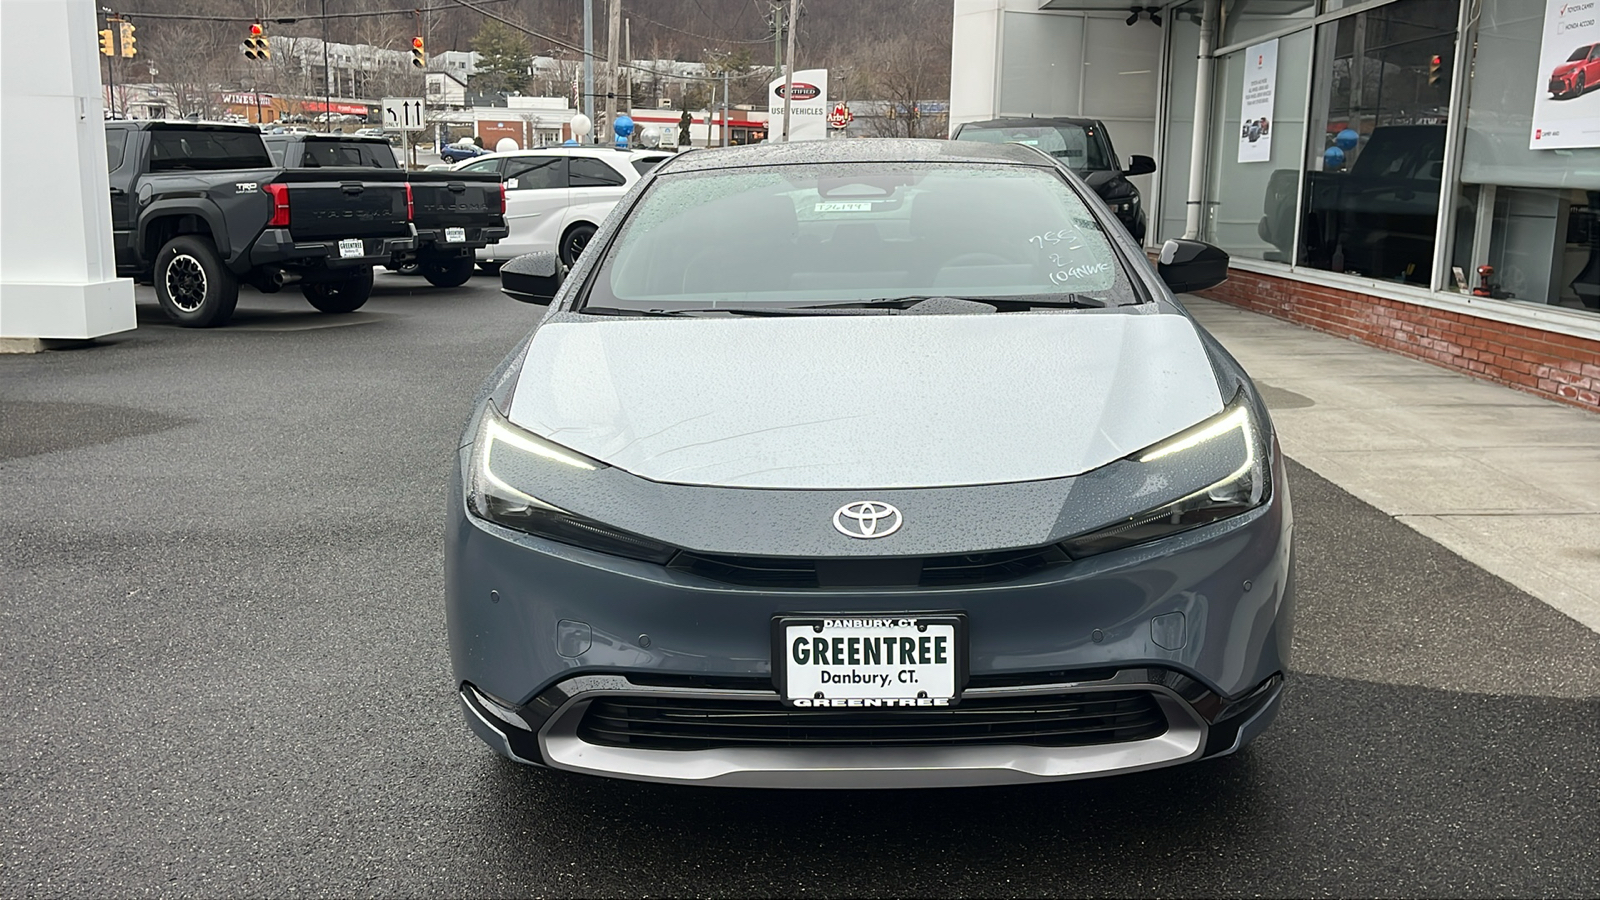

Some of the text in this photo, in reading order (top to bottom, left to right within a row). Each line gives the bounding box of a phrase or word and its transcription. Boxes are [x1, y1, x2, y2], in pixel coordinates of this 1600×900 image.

[771, 107, 824, 116] USE VEHICLES
[423, 203, 489, 211] TACOMA
[313, 209, 393, 219] TACOMA
[340, 242, 362, 250] GREENTREE
[823, 619, 894, 629] DANBURY,
[792, 636, 947, 666] GREENTREE
[821, 669, 919, 688] Danbury, CT.
[793, 698, 950, 707] GREENTREE
